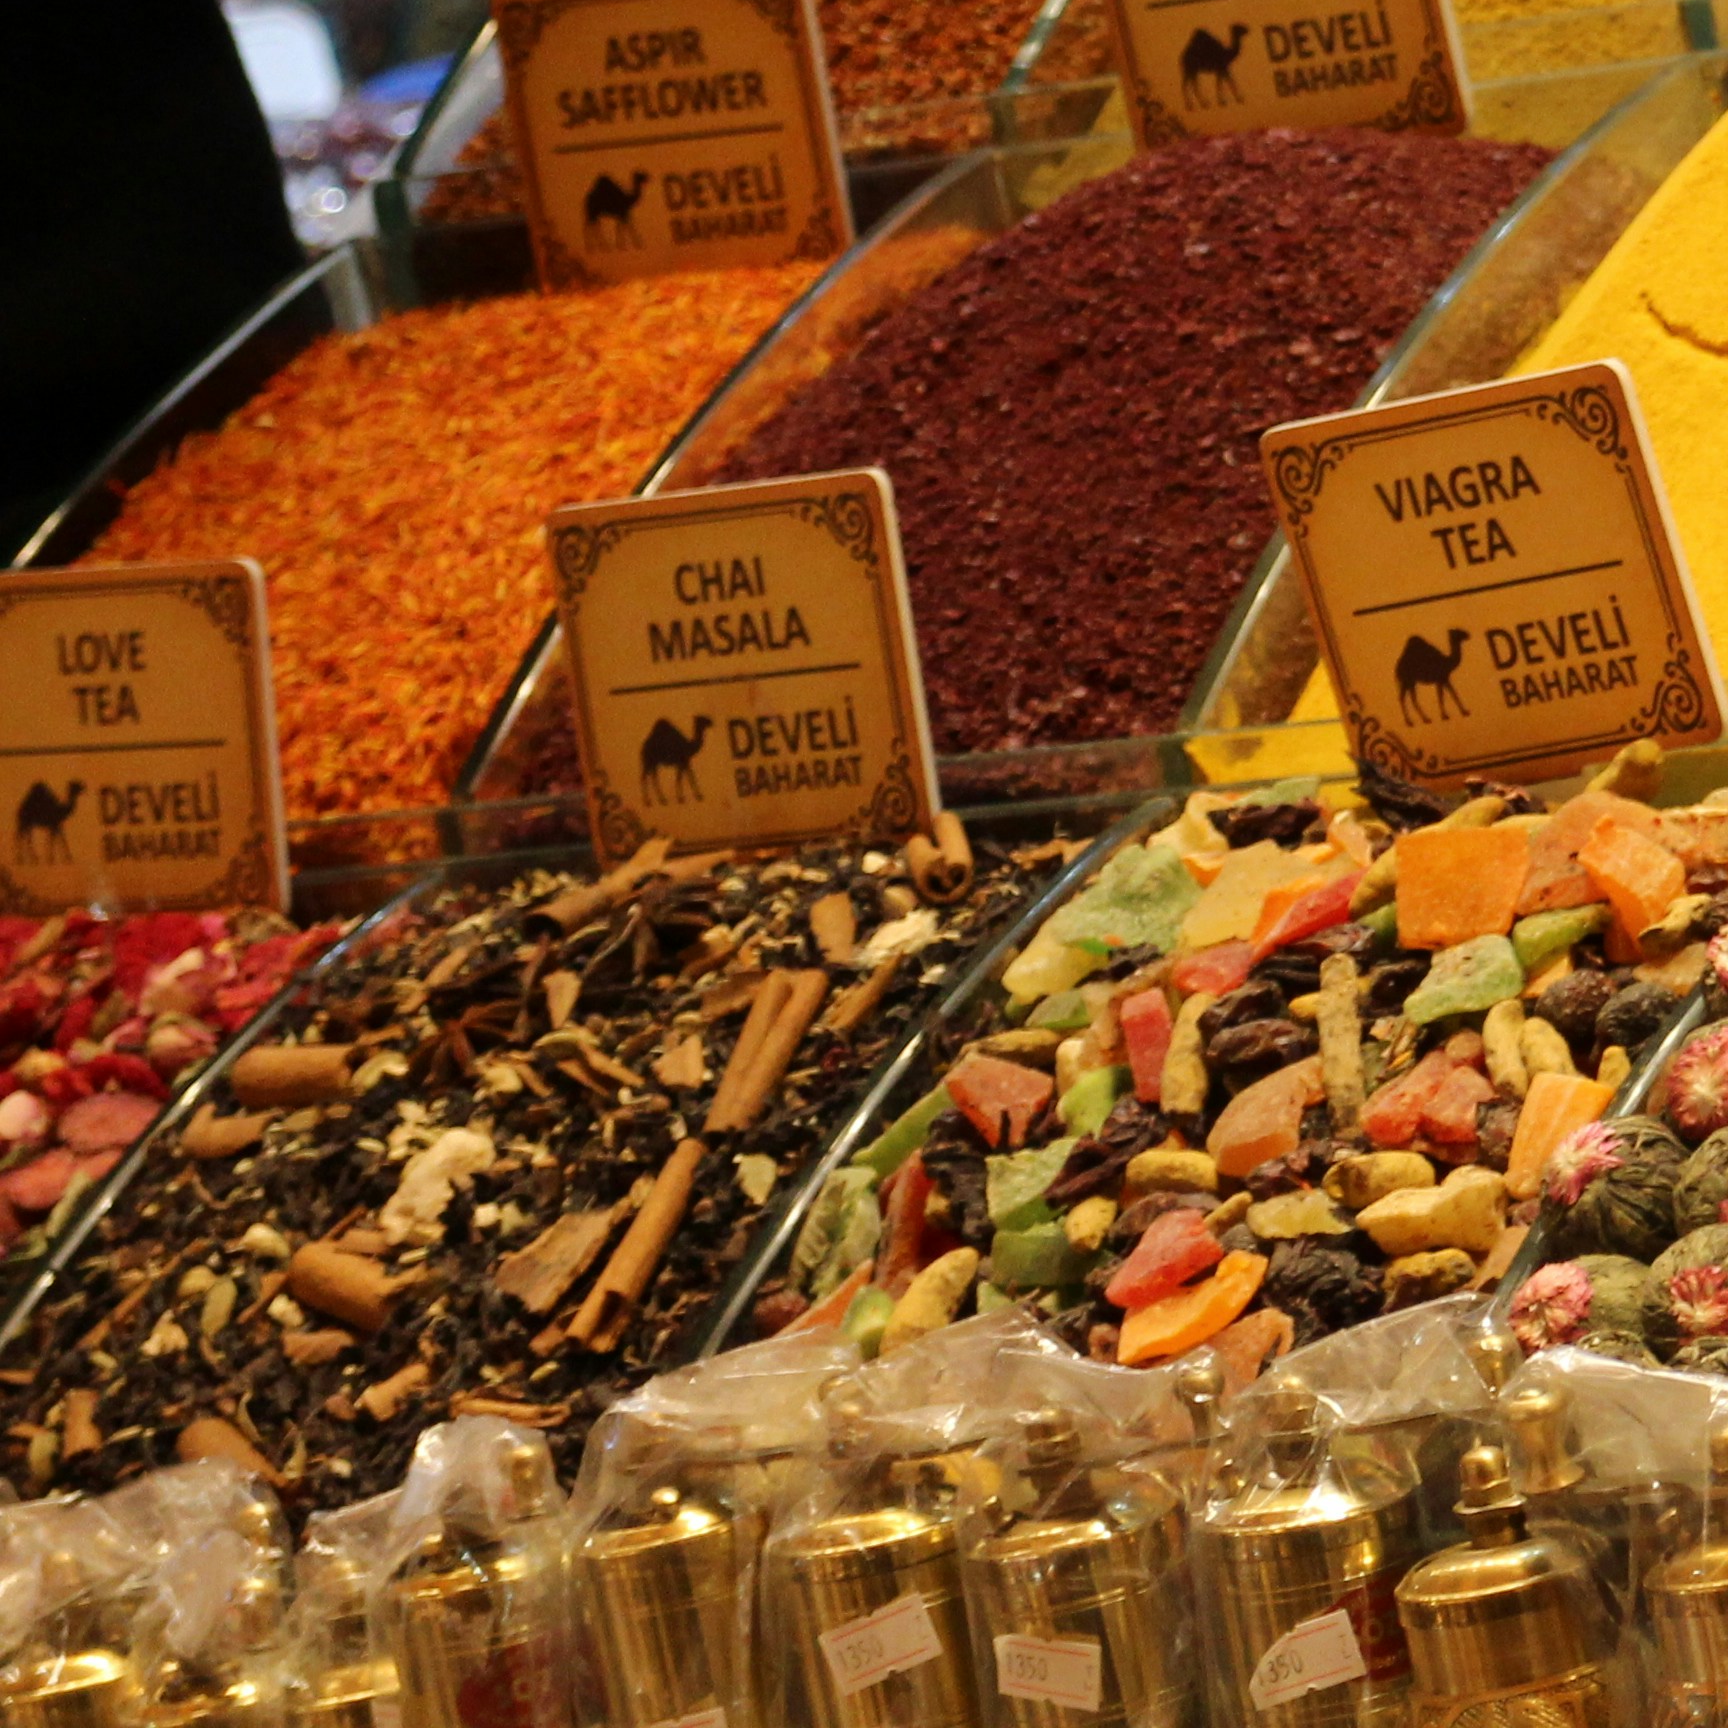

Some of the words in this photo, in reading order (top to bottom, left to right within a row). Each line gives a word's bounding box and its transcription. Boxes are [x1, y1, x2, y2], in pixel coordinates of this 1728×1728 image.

[605, 26, 706, 72] ASPIR
[556, 69, 769, 130] SAFFLOWER
[1274, 53, 1398, 98] BAHARAT
[1374, 454, 1542, 523] VIAGRA
[1431, 518, 1516, 570] TEA
[673, 555, 766, 606] CHAI
[56, 630, 148, 676] LOVE
[647, 607, 811, 664] MASALA
[72, 684, 141, 726] TEA
[1499, 655, 1639, 709] BAHARAT
[734, 756, 863, 799] BAHARAT
